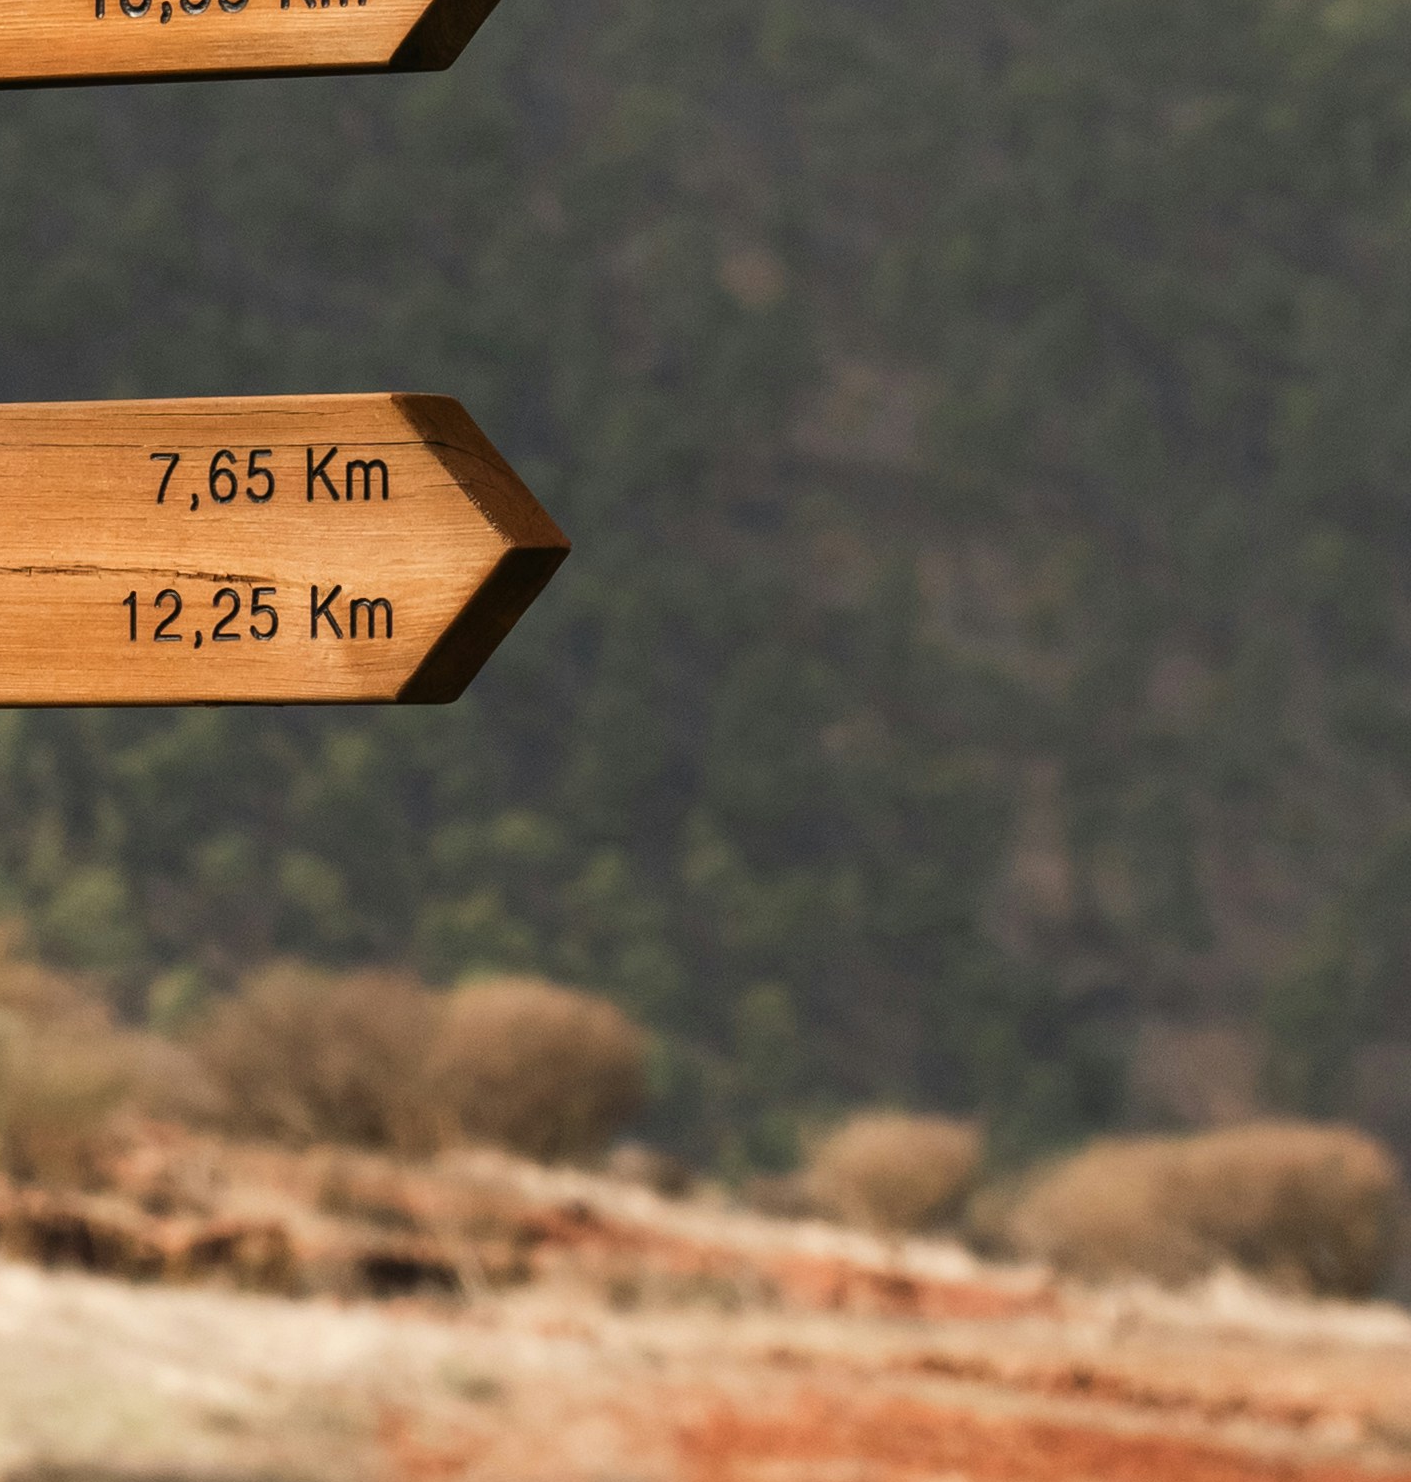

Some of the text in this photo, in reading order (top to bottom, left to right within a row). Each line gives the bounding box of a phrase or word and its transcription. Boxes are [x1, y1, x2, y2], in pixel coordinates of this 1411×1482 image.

[149, 446, 389, 512] 7,65 Km
[122, 584, 393, 650] 12,25 Km
